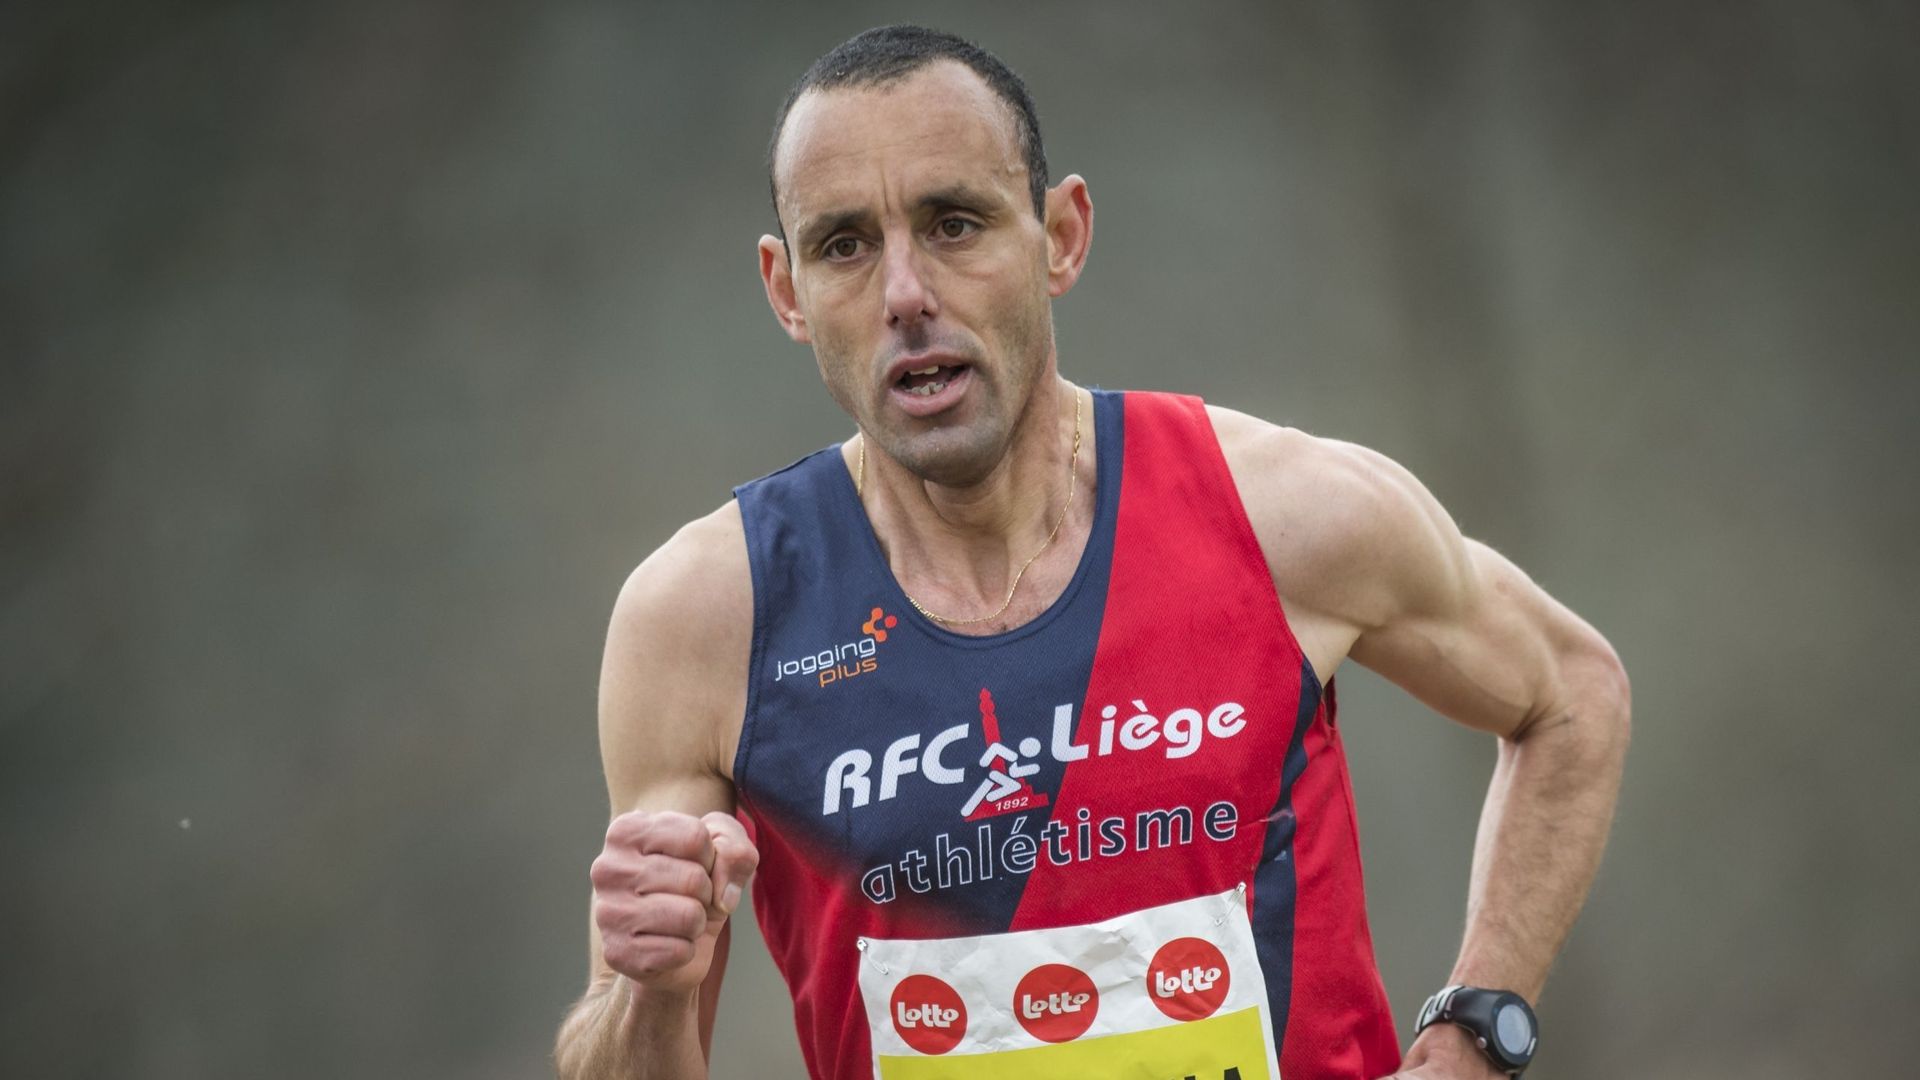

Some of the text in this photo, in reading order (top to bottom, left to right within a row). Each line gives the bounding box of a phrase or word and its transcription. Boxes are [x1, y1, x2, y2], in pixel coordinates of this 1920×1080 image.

[775, 638, 876, 681] jogging
[819, 658, 878, 688] plus
[823, 699, 1246, 816] RFC Liège
[995, 796, 1029, 811] 1892
[861, 801, 1239, 905] athlétisme
